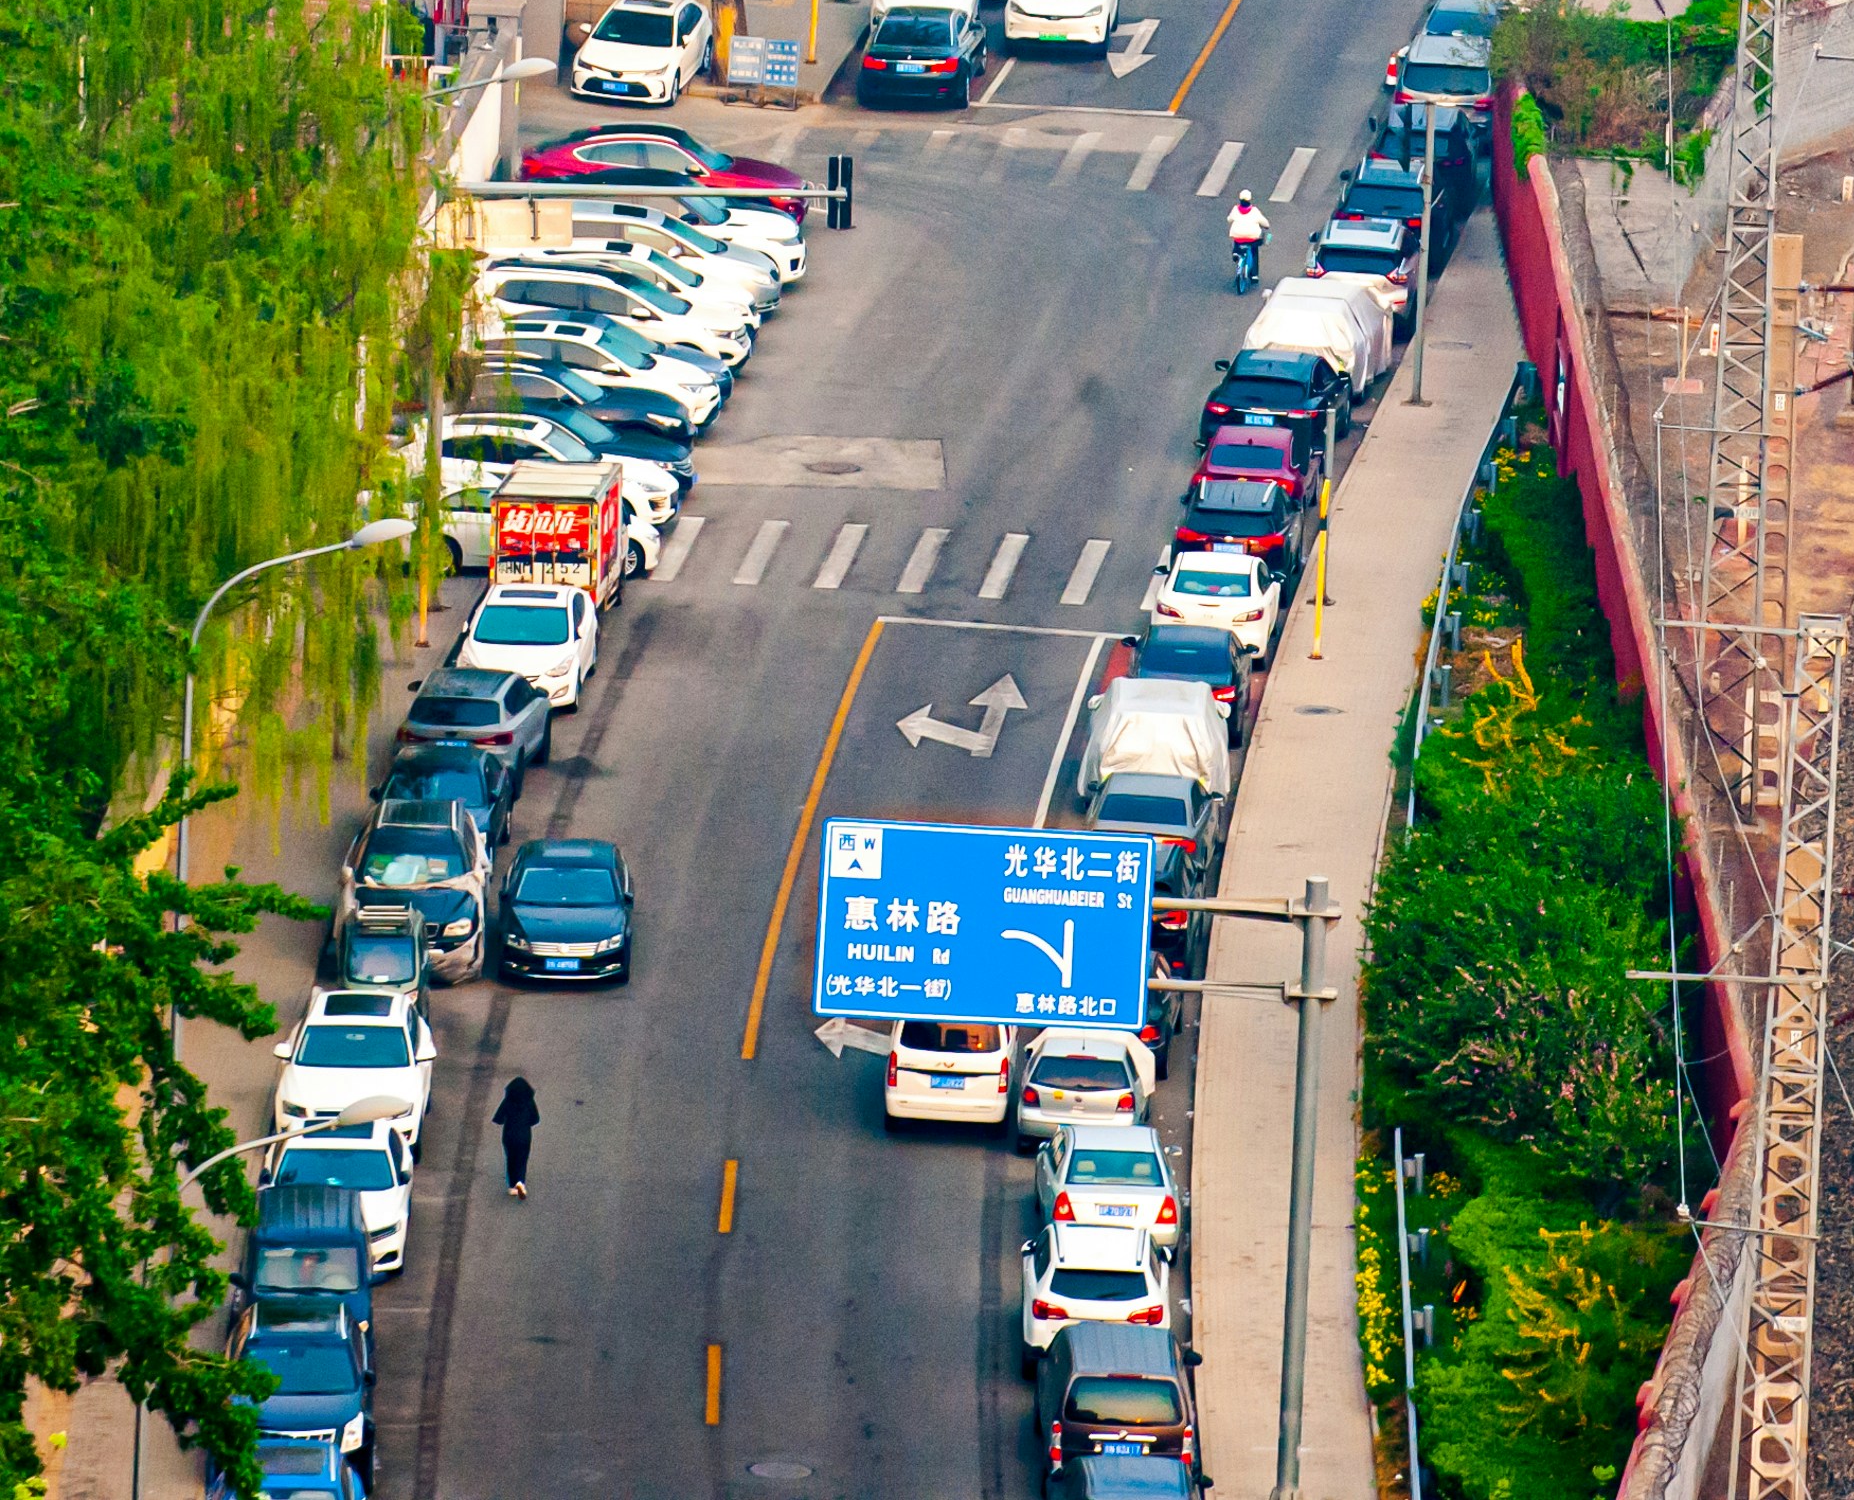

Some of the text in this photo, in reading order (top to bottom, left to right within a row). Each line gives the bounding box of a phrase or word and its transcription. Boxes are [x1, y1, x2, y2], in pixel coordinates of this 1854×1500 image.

[501, 509, 576, 535] 货拉拉
[839, 833, 856, 851] 西
[864, 837, 876, 850] W
[1003, 843, 1141, 885] 光华北二街
[1003, 887, 1133, 910] GUANGHUABEIER St
[843, 895, 961, 936] 惠林路
[847, 943, 951, 966] HUILIN Rd
[826, 974, 952, 1001] (光华北一街)
[1015, 992, 1117, 1017] 惠林路北口
